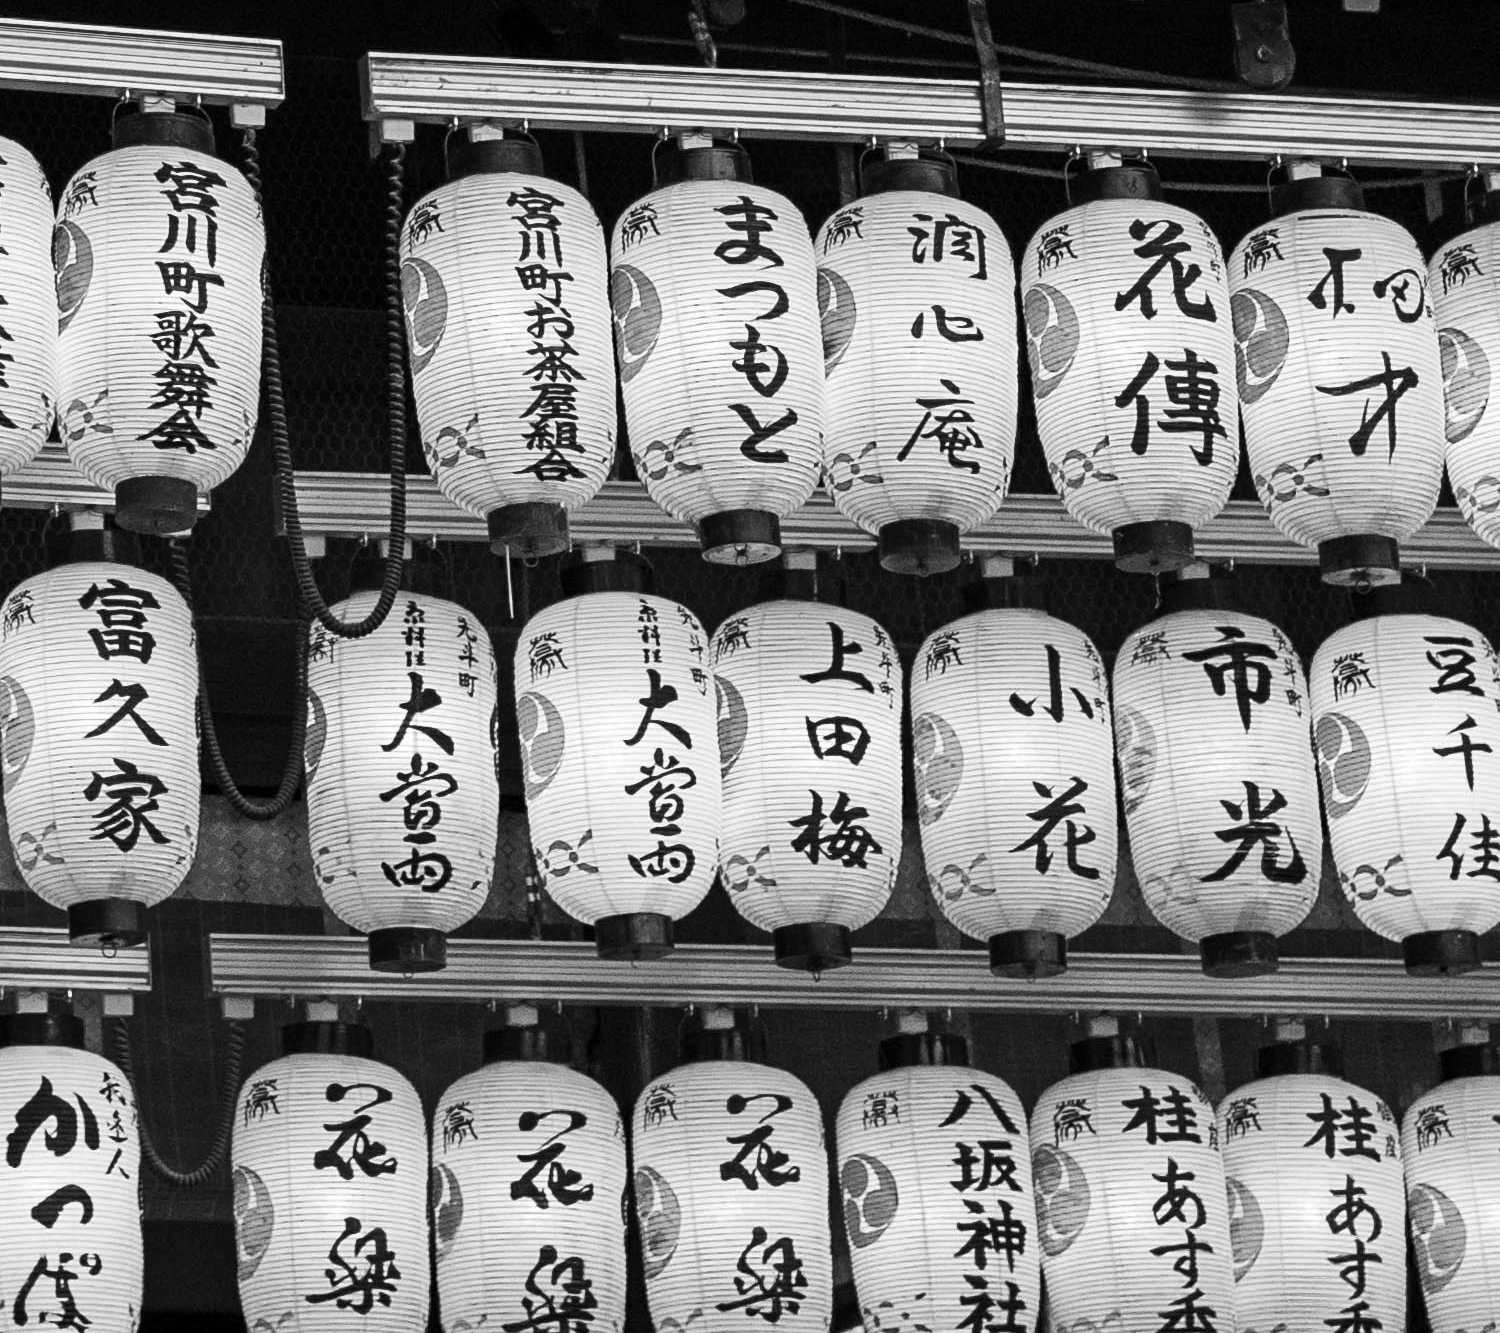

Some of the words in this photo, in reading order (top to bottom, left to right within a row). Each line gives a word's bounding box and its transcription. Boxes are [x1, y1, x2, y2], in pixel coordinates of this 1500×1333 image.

[136, 162, 227, 454] 宮川町歌舞会
[506, 187, 589, 484] 宮川町お茶屋組合
[713, 195, 798, 464] まつもと
[78, 579, 171, 852] 富久家
[788, 622, 886, 869] 上田梅
[1008, 640, 1100, 879] 小花
[1181, 626, 1308, 884] 市光
[938, 1083, 1028, 1333] 八坂神社
